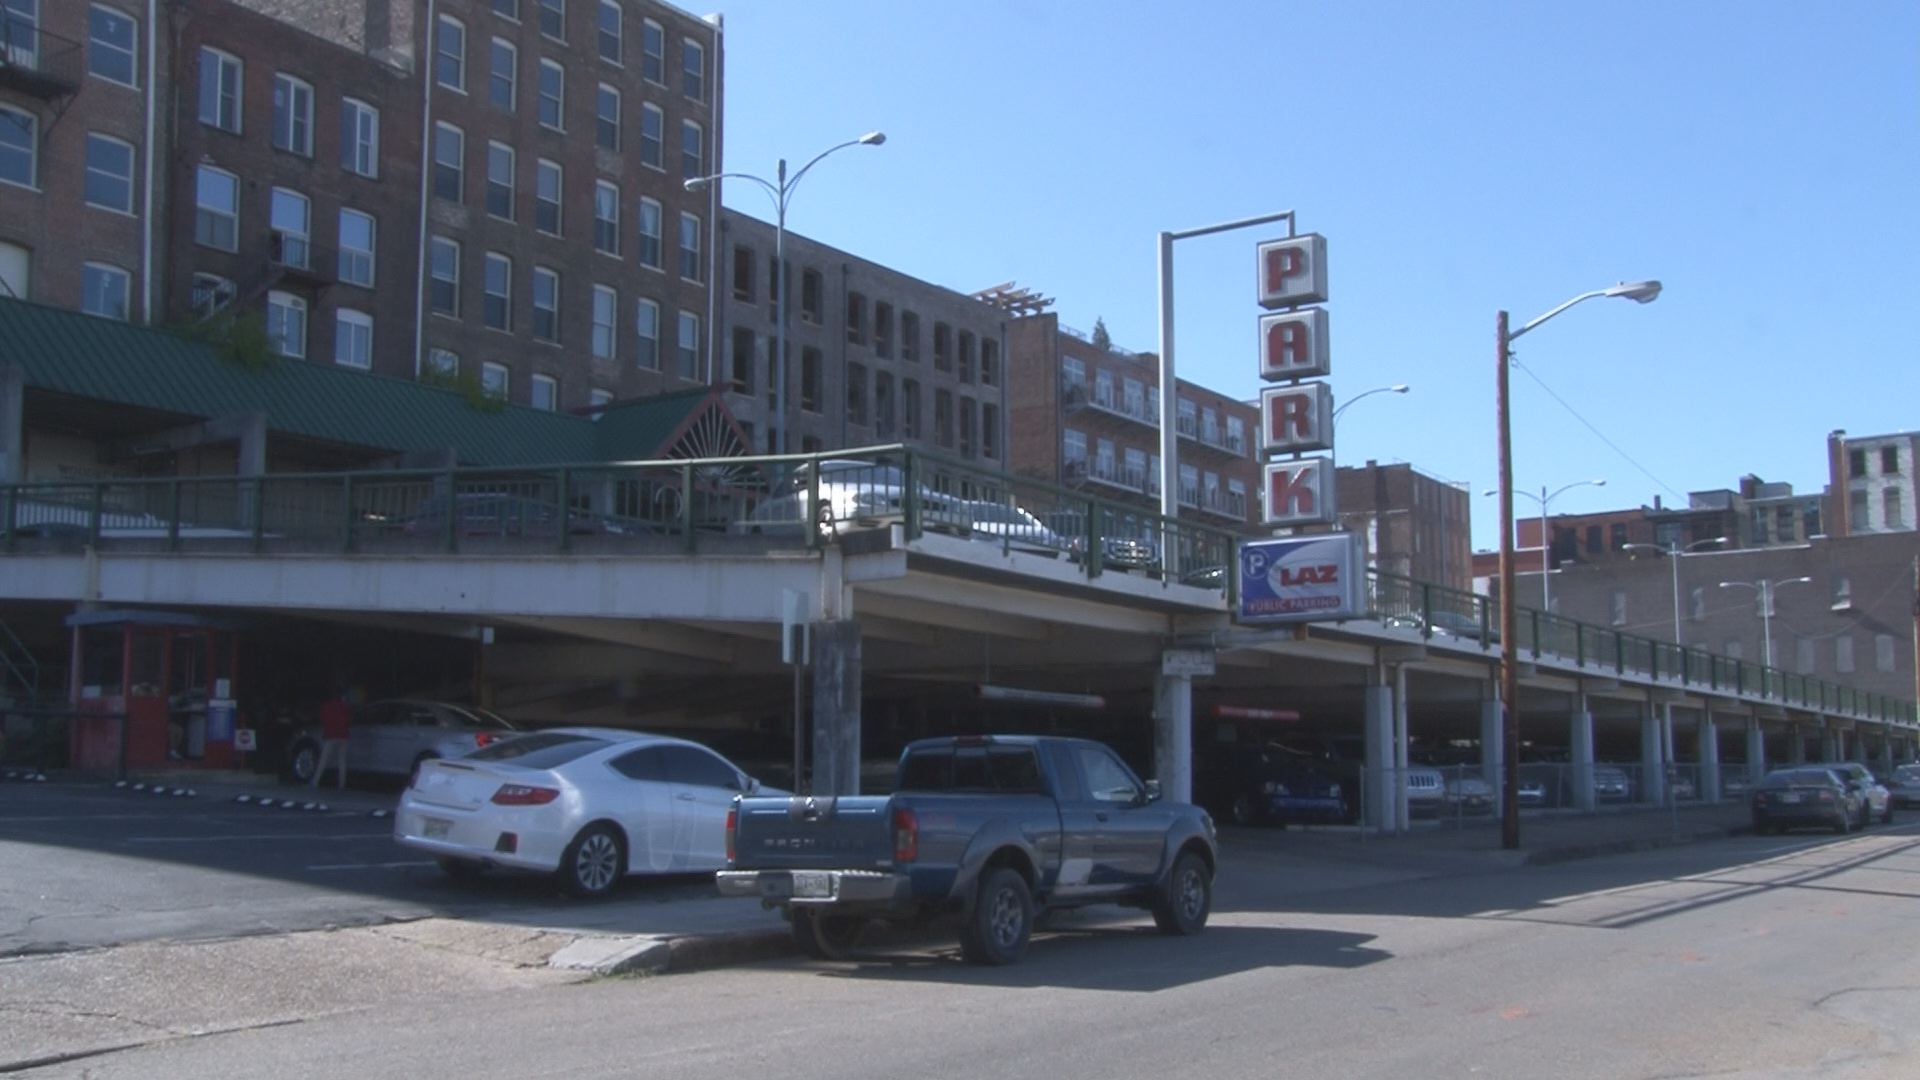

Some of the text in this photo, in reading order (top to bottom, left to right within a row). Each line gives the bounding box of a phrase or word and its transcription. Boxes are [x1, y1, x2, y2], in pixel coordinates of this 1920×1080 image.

[1266, 246, 1312, 515] PARK
[1250, 553, 1264, 575] P
[1280, 564, 1338, 587] LAZ
[1249, 596, 1339, 612] PUBLIC PARKING
